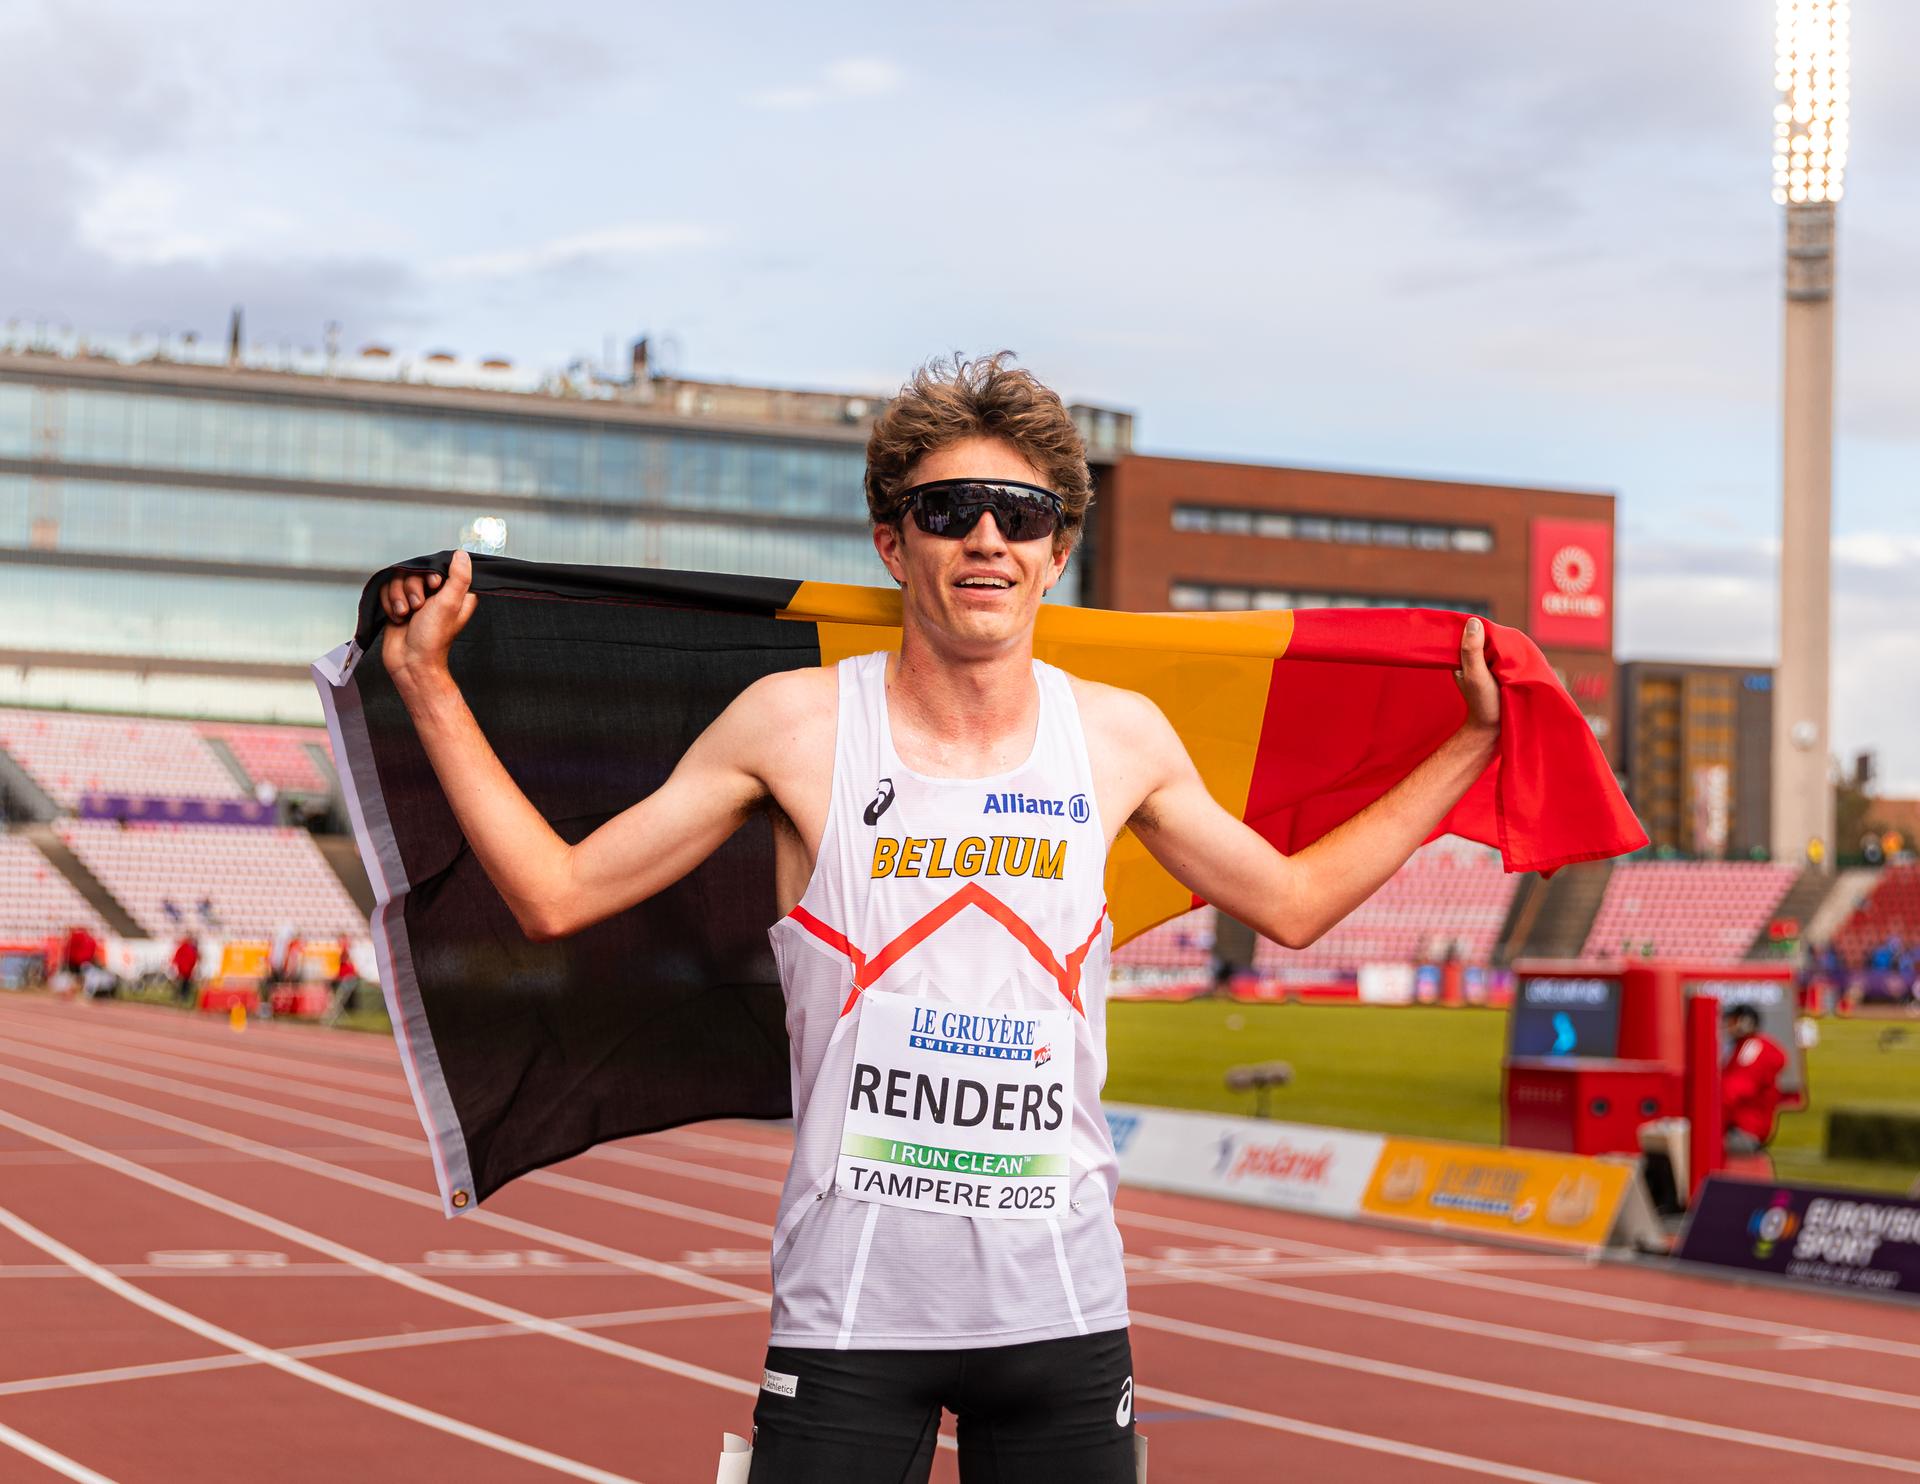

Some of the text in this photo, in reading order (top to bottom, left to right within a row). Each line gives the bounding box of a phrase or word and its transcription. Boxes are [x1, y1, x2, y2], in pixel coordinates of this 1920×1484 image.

[983, 793, 1065, 816] Allianz
[870, 836, 1067, 880] BELGIUM
[911, 1006, 1036, 1046] LE GRUYÈRE
[914, 1037, 1029, 1060] SWITZERLAND
[850, 1063, 1064, 1132] RENDERS
[890, 1143, 898, 1161] I
[901, 1145, 949, 1168] RUN
[850, 1166, 1056, 1210] TAMPERE 2025
[767, 1381, 794, 1395] Athletics
